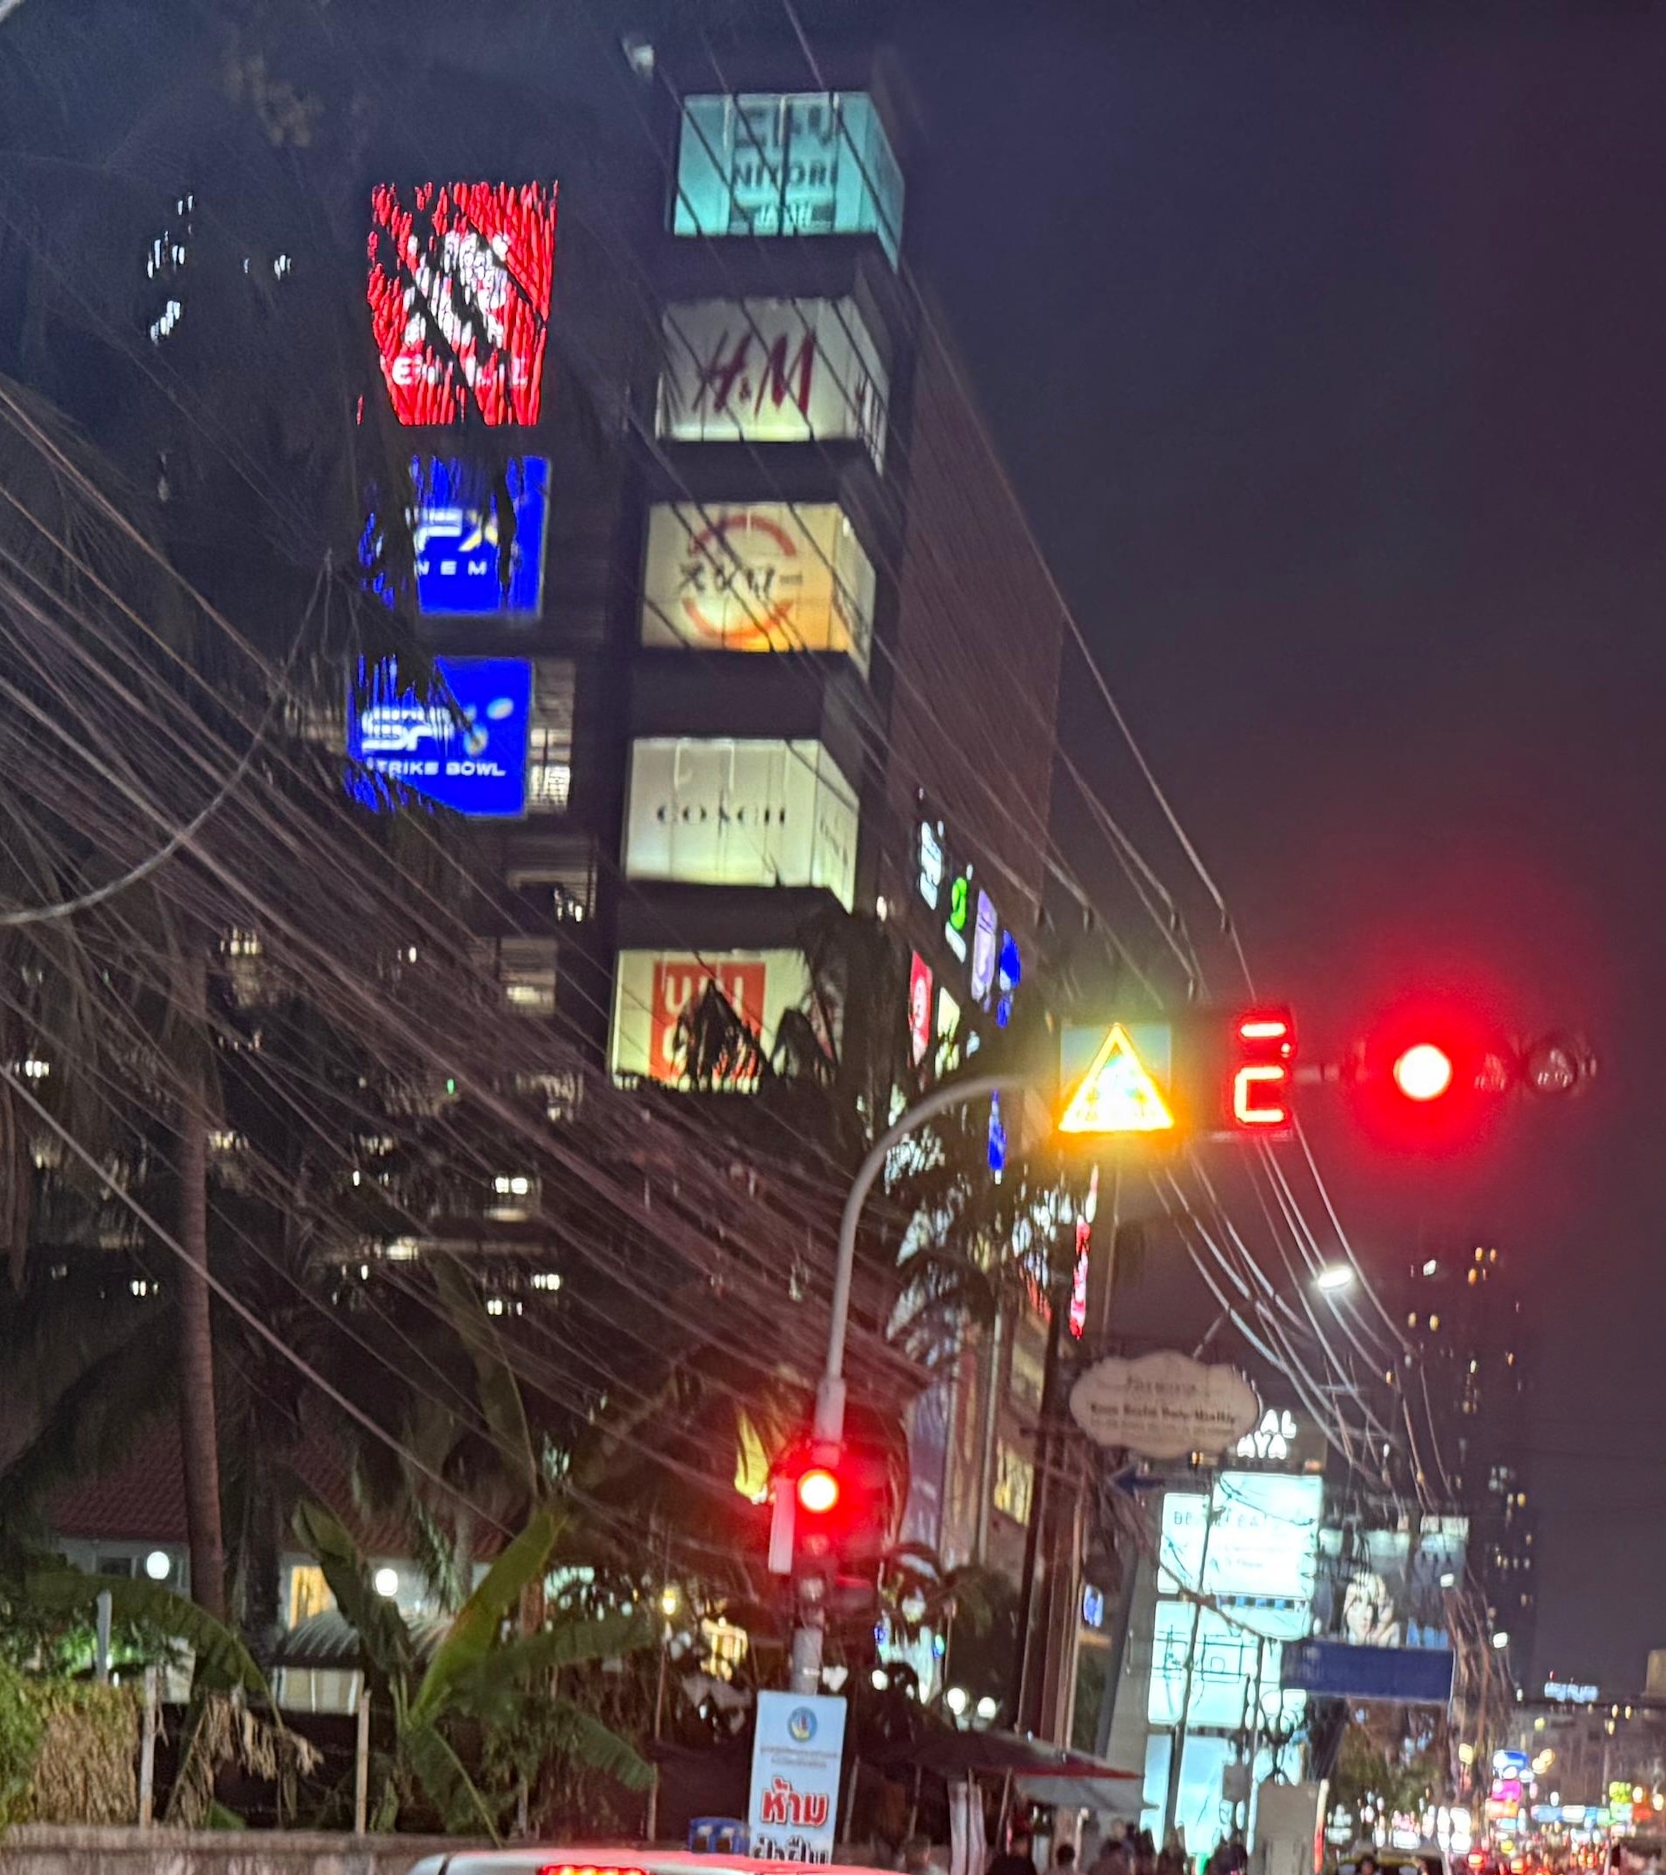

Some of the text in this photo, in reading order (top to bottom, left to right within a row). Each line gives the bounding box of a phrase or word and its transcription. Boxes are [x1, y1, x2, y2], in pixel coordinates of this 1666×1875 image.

[691, 329, 816, 417] H&M
[446, 760, 506, 777] BOWL
[761, 1775, 829, 1828] ห้าม
